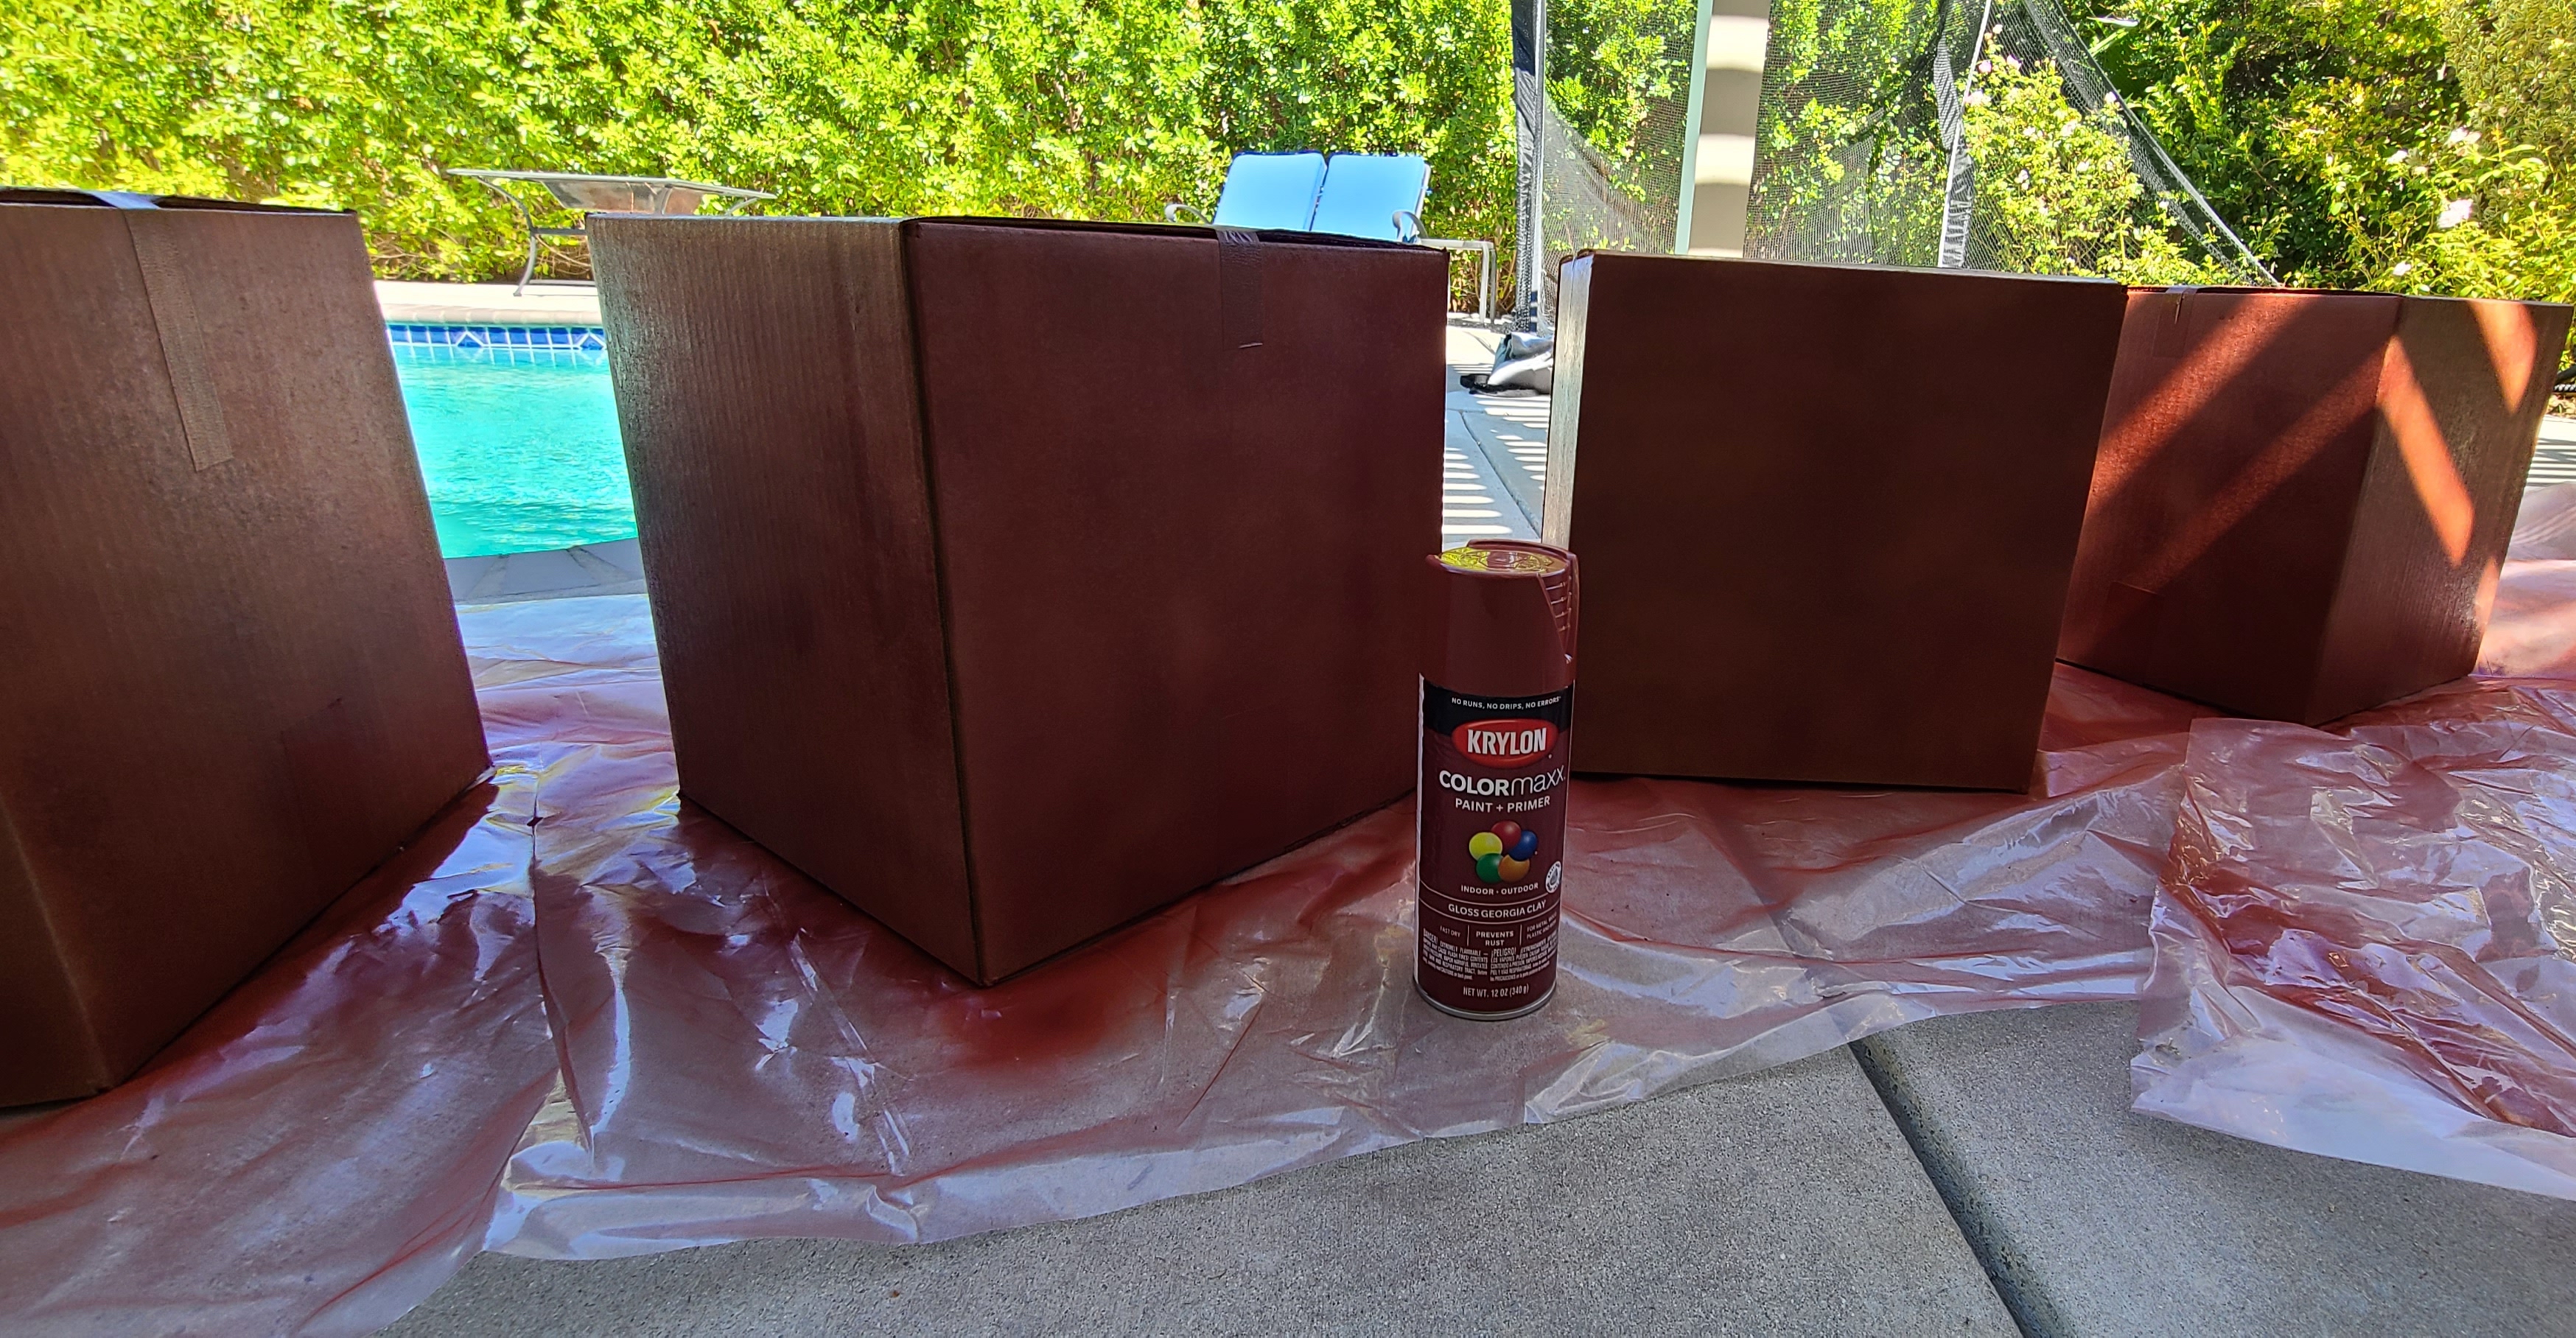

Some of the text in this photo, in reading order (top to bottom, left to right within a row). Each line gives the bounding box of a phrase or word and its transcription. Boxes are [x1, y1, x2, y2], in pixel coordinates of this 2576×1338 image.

[1463, 700, 1485, 710] RUNS,
[1467, 727, 1547, 756] KRYLON
[1455, 796, 1550, 813] PAINT + PRIMER
[1460, 883, 1539, 895] INDOOR OUTDOOR
[1448, 900, 1546, 919] GLOSS GEORGIA CLAY
[1440, 925, 1461, 938] FAST DRY
[1476, 930, 1514, 939] PREVENTS
[1463, 986, 1475, 997] NET
[1477, 988, 1489, 998] WT.
[1491, 989, 1499, 998] 12
[1499, 987, 1508, 997] OZ
[1509, 985, 1522, 998] (340
